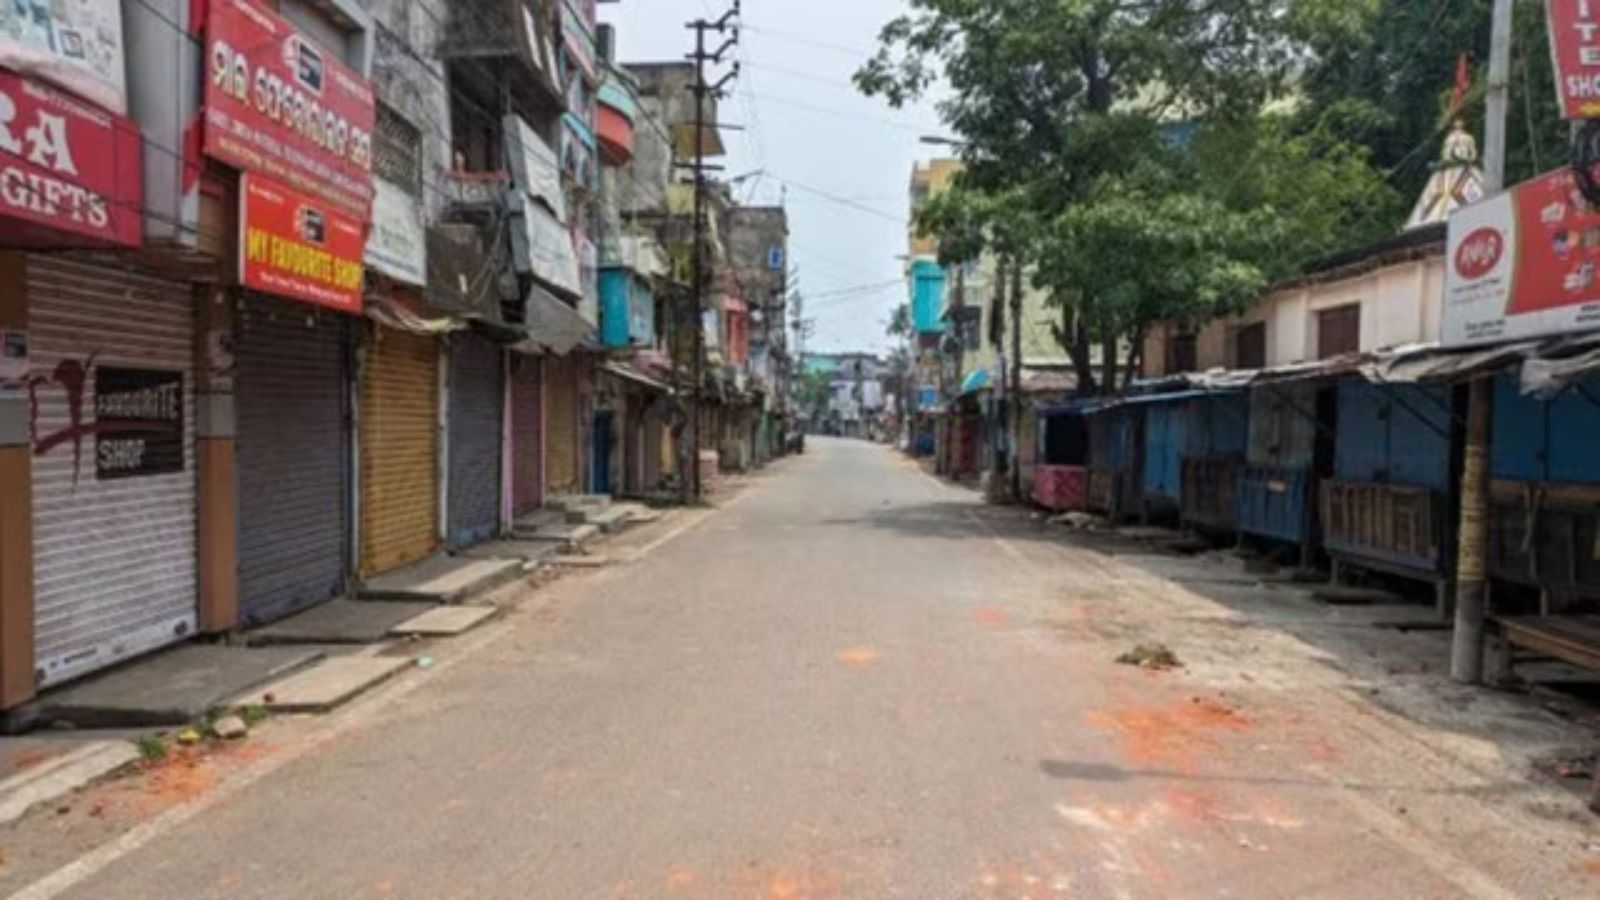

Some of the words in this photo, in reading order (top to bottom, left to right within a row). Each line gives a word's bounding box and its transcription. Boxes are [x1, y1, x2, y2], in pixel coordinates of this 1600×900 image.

[1, 166, 107, 227] GIFTS
[247, 225, 267, 264] MY
[271, 234, 332, 283] FAVOURITE
[334, 256, 362, 291] SHOP
[100, 438, 146, 470] SHOP
